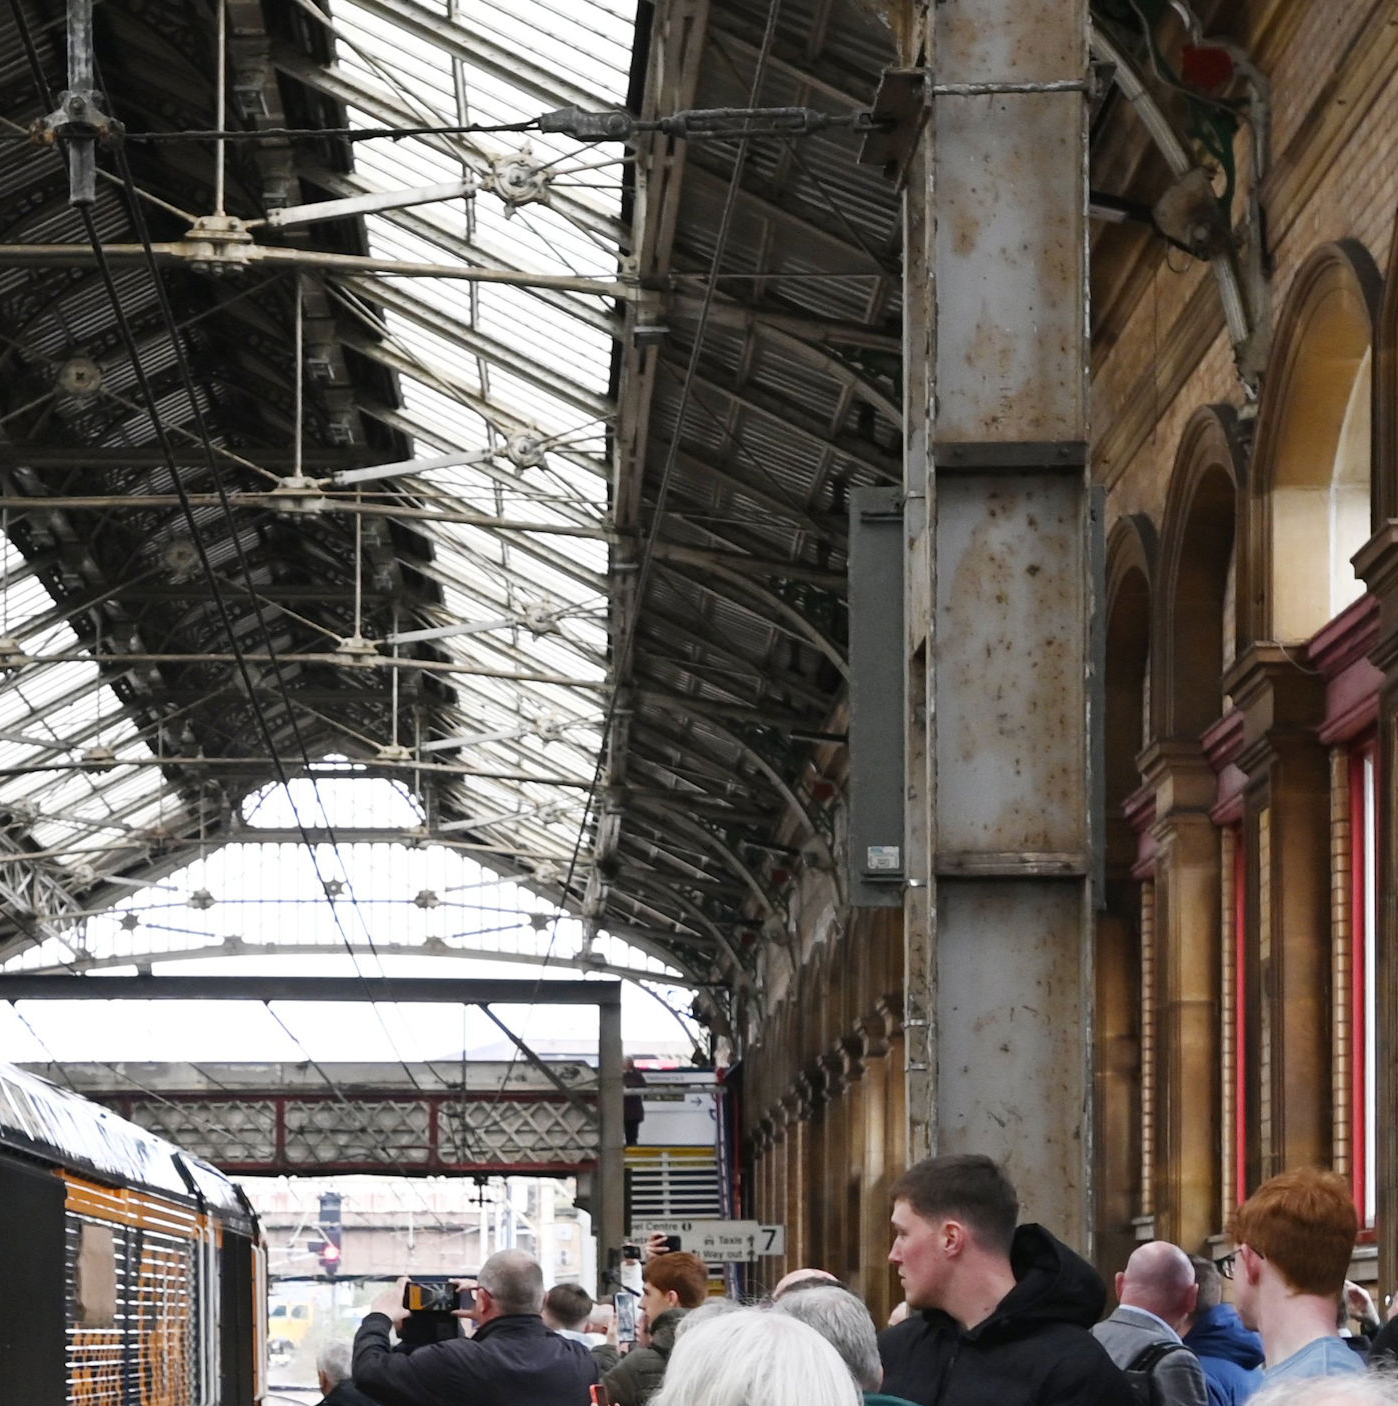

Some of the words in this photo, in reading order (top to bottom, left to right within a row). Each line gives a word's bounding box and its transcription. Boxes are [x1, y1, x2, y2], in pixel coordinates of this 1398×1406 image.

[646, 1222, 678, 1231] Centre
[718, 1235, 743, 1245] Taxis
[761, 1229, 776, 1251] 7
[703, 1250, 724, 1260] Way
[727, 1250, 743, 1258] out
